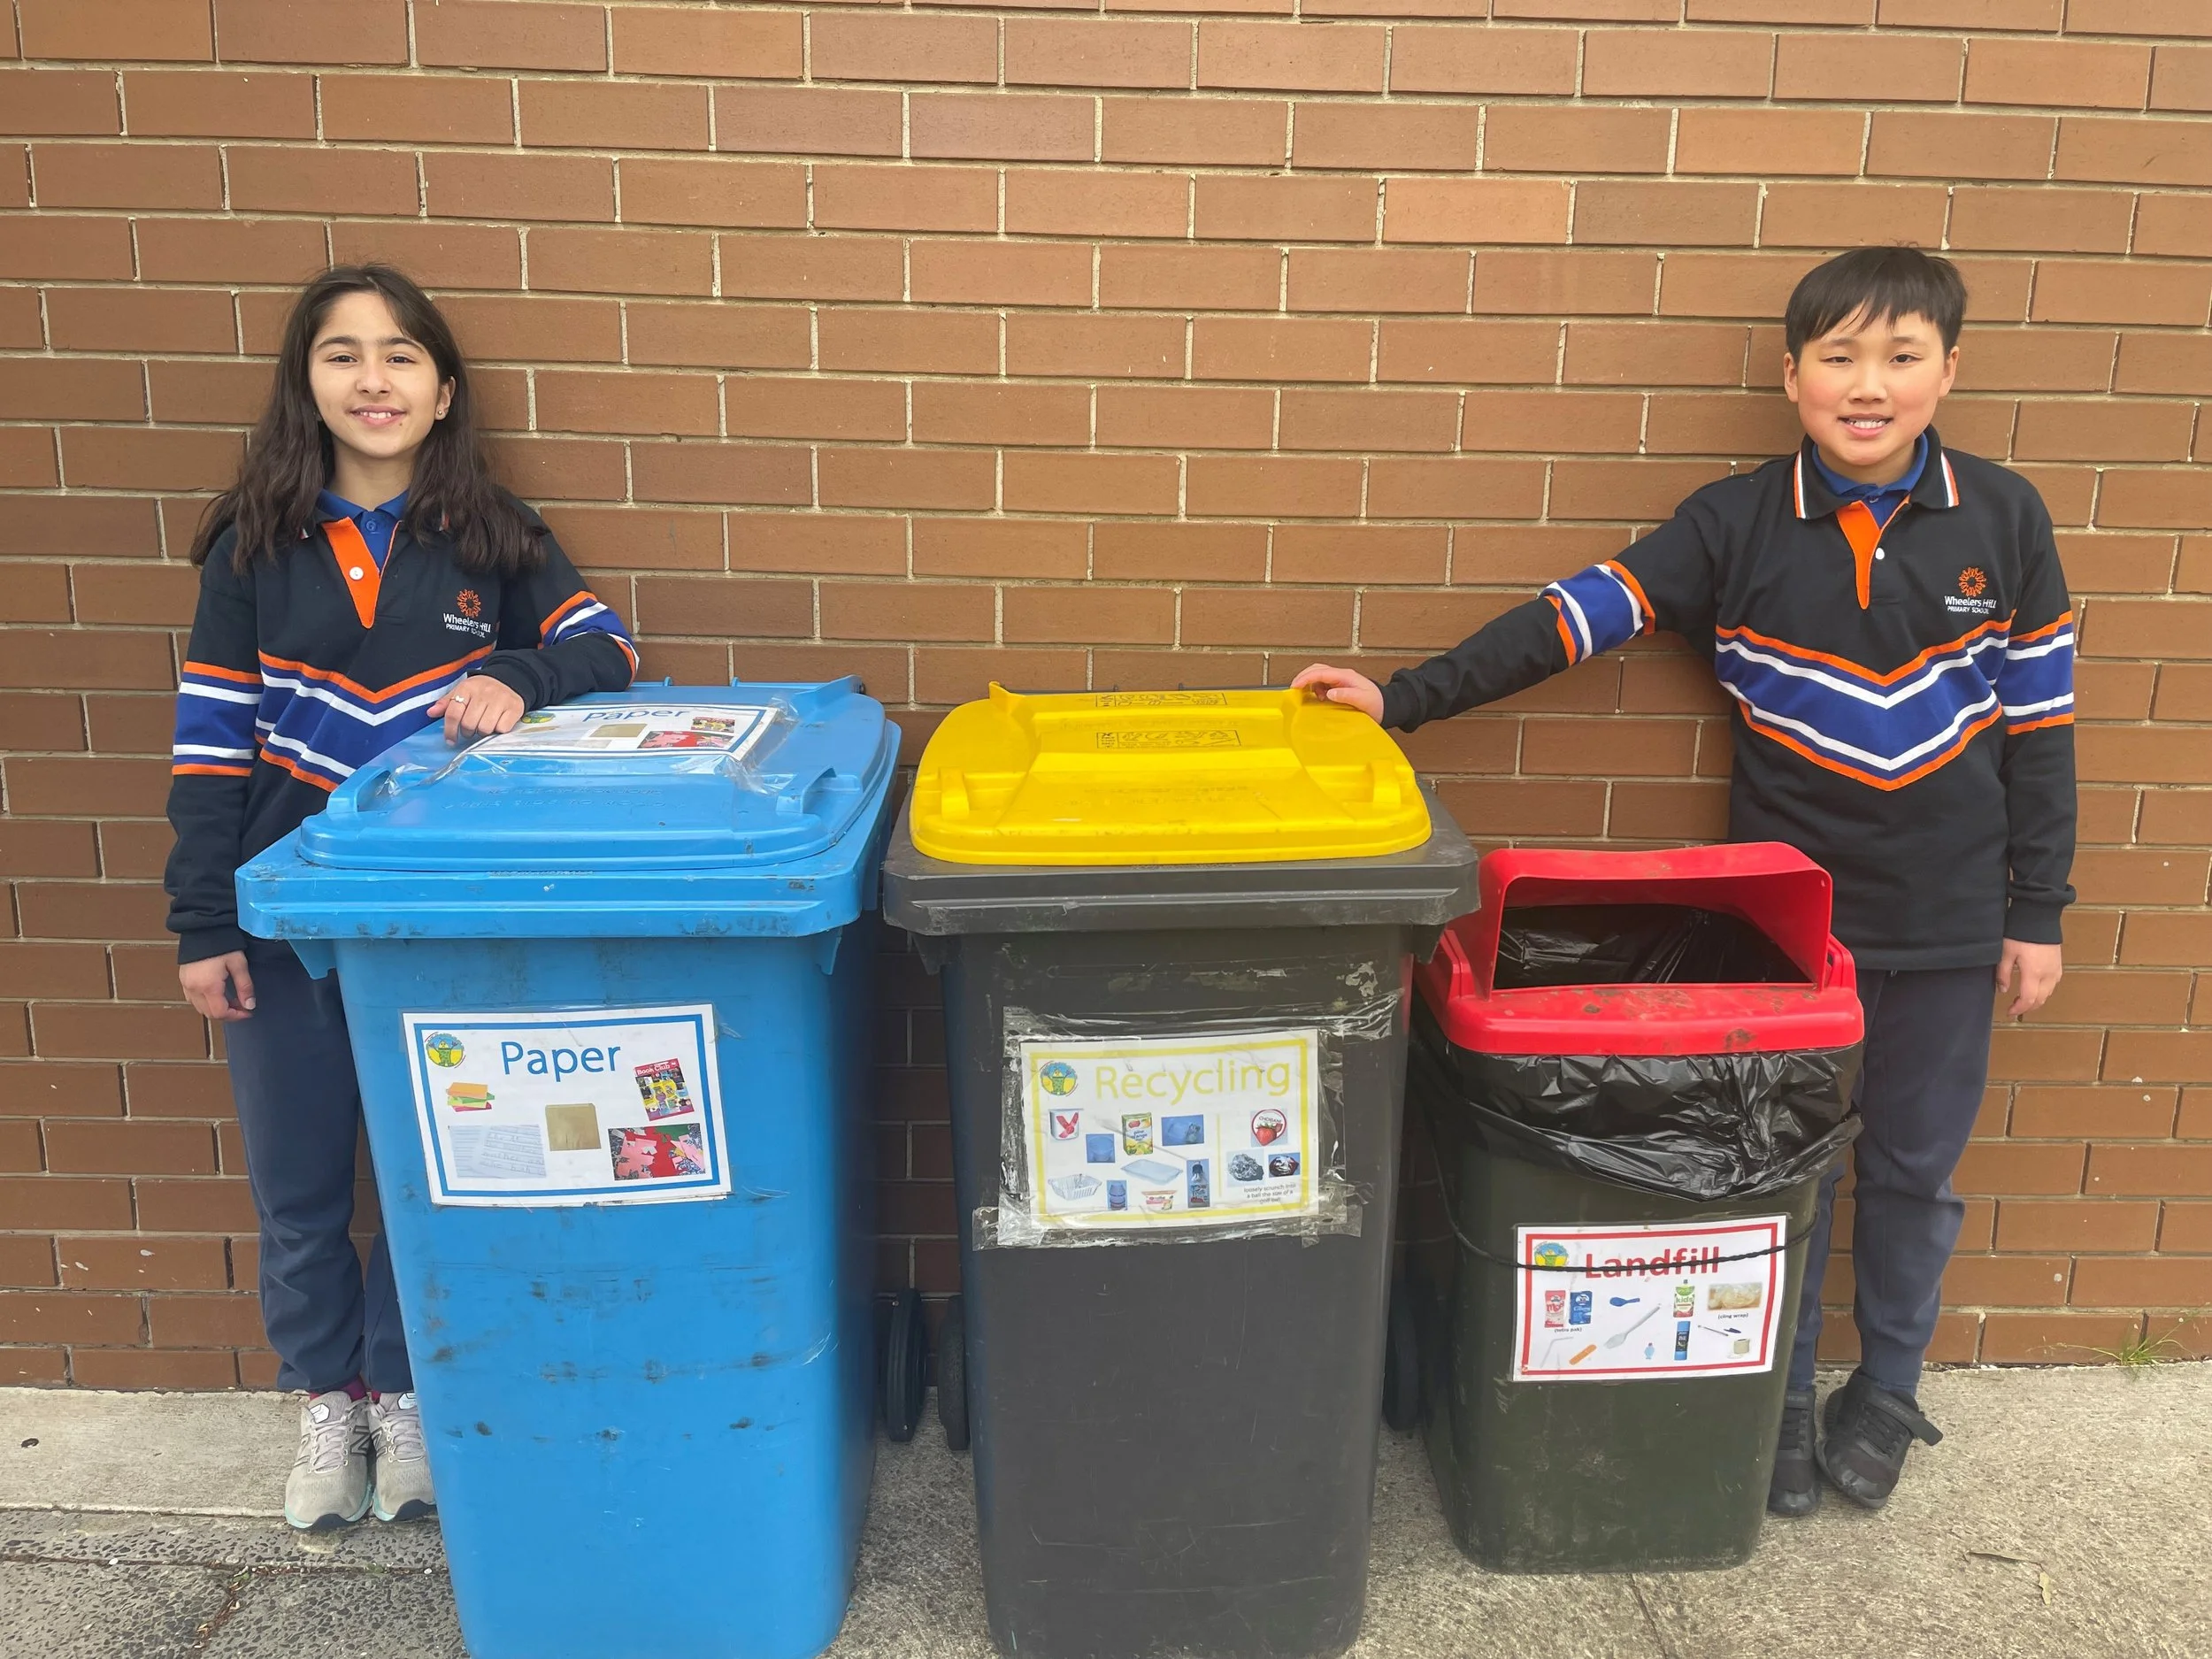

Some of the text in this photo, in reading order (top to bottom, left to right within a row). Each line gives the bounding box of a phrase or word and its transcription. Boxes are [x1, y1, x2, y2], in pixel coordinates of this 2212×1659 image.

[1944, 595, 1982, 608] Wheelers
[443, 612, 479, 628] Wheelers
[446, 623, 469, 632] PRIMARY
[582, 709, 690, 723] Paper
[501, 1041, 621, 1083] Paper
[637, 1064, 671, 1076] Book Club
[1094, 1058, 1290, 1106] Recycling
[1586, 1246, 1720, 1279] Landfill
